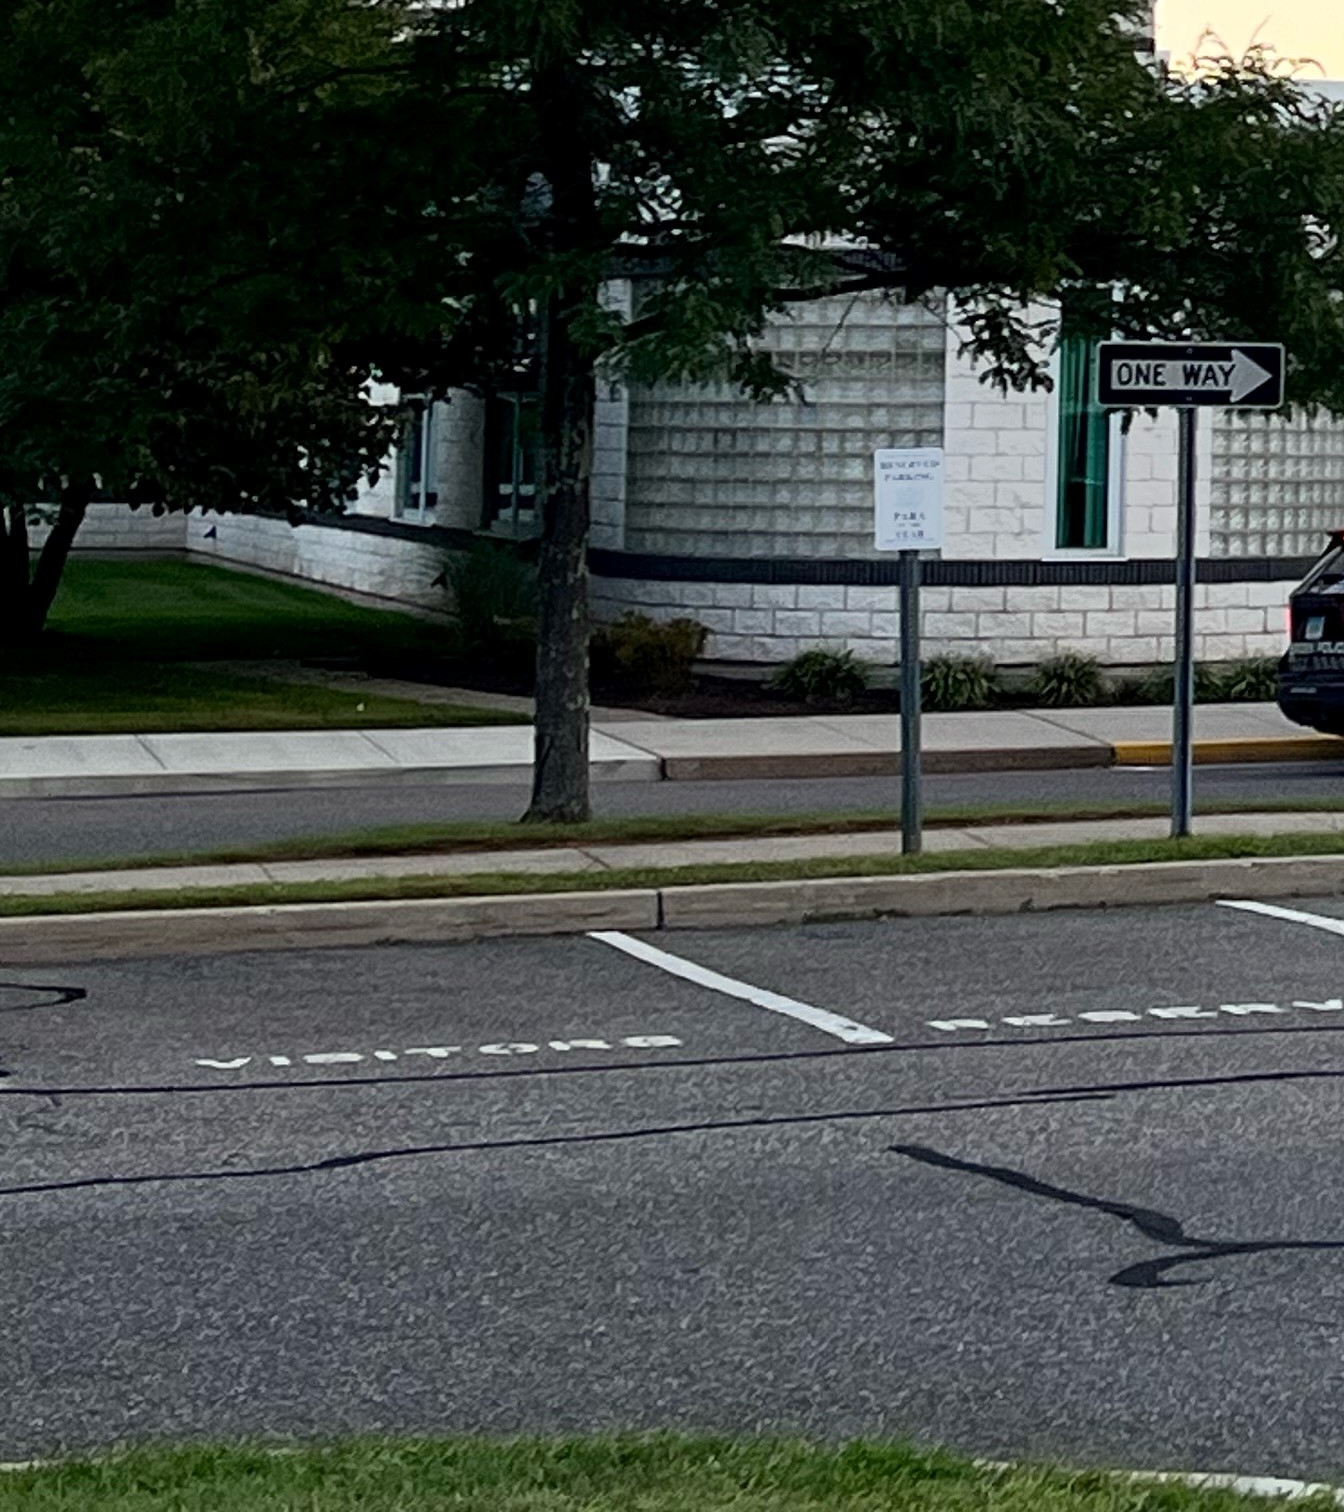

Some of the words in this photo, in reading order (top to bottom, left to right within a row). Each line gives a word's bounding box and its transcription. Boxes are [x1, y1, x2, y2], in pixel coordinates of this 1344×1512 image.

[1117, 363, 1166, 386] ONE
[1183, 364, 1236, 386] WAY
[195, 1035, 683, 1068] VISITORS
